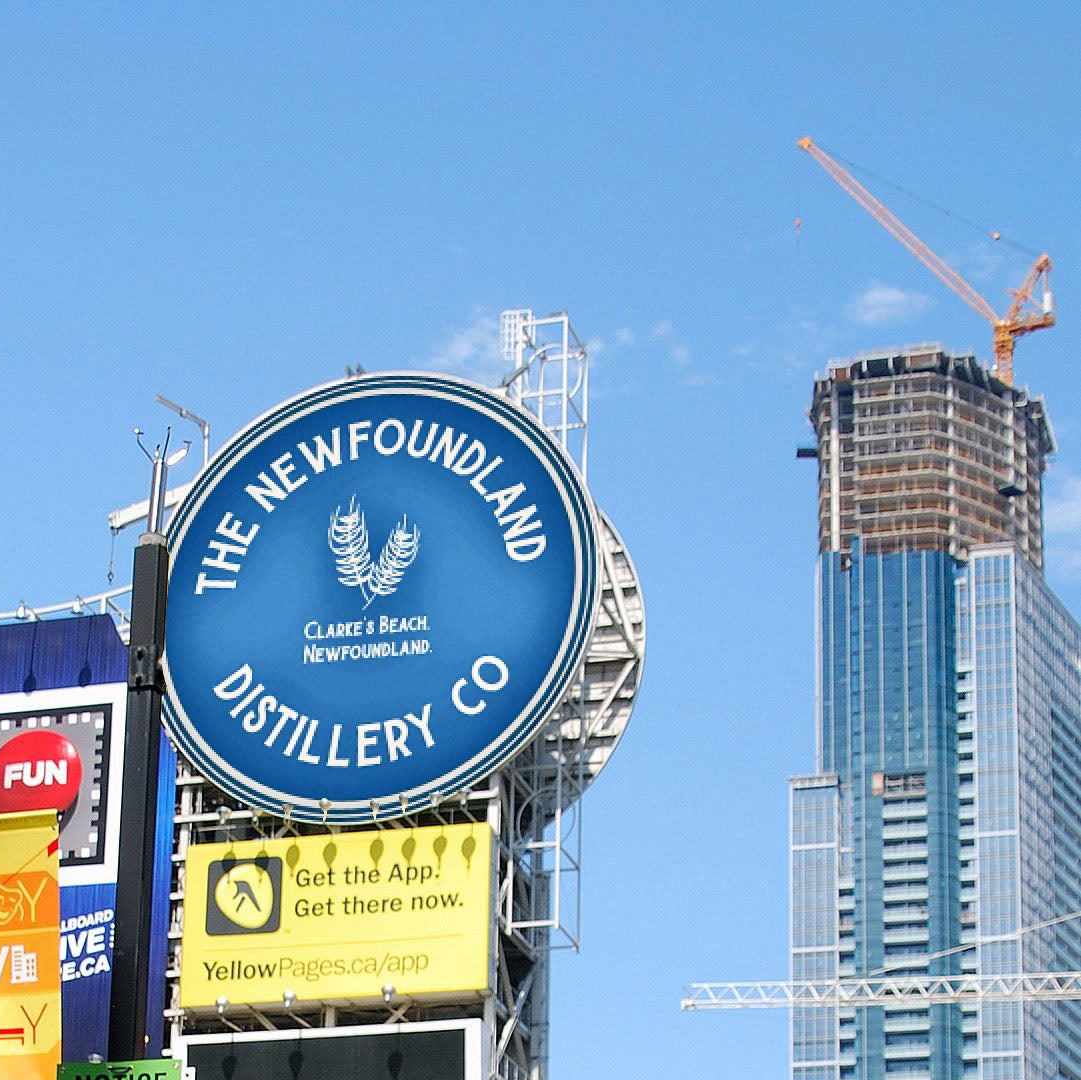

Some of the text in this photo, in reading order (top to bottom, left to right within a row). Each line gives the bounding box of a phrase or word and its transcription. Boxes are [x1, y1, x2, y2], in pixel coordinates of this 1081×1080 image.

[195, 419, 546, 594] THE NEWFOUNDLAND
[213, 655, 509, 768] DISTILLERY CO
[3, 758, 68, 790] FUN
[296, 864, 440, 888] Get the App.
[294, 892, 465, 917] Get there now.
[60, 908, 114, 933] LBOARD
[59, 926, 106, 961] IVE
[60, 954, 111, 982] E.CA
[204, 952, 429, 982] YellowPages.ca/app
